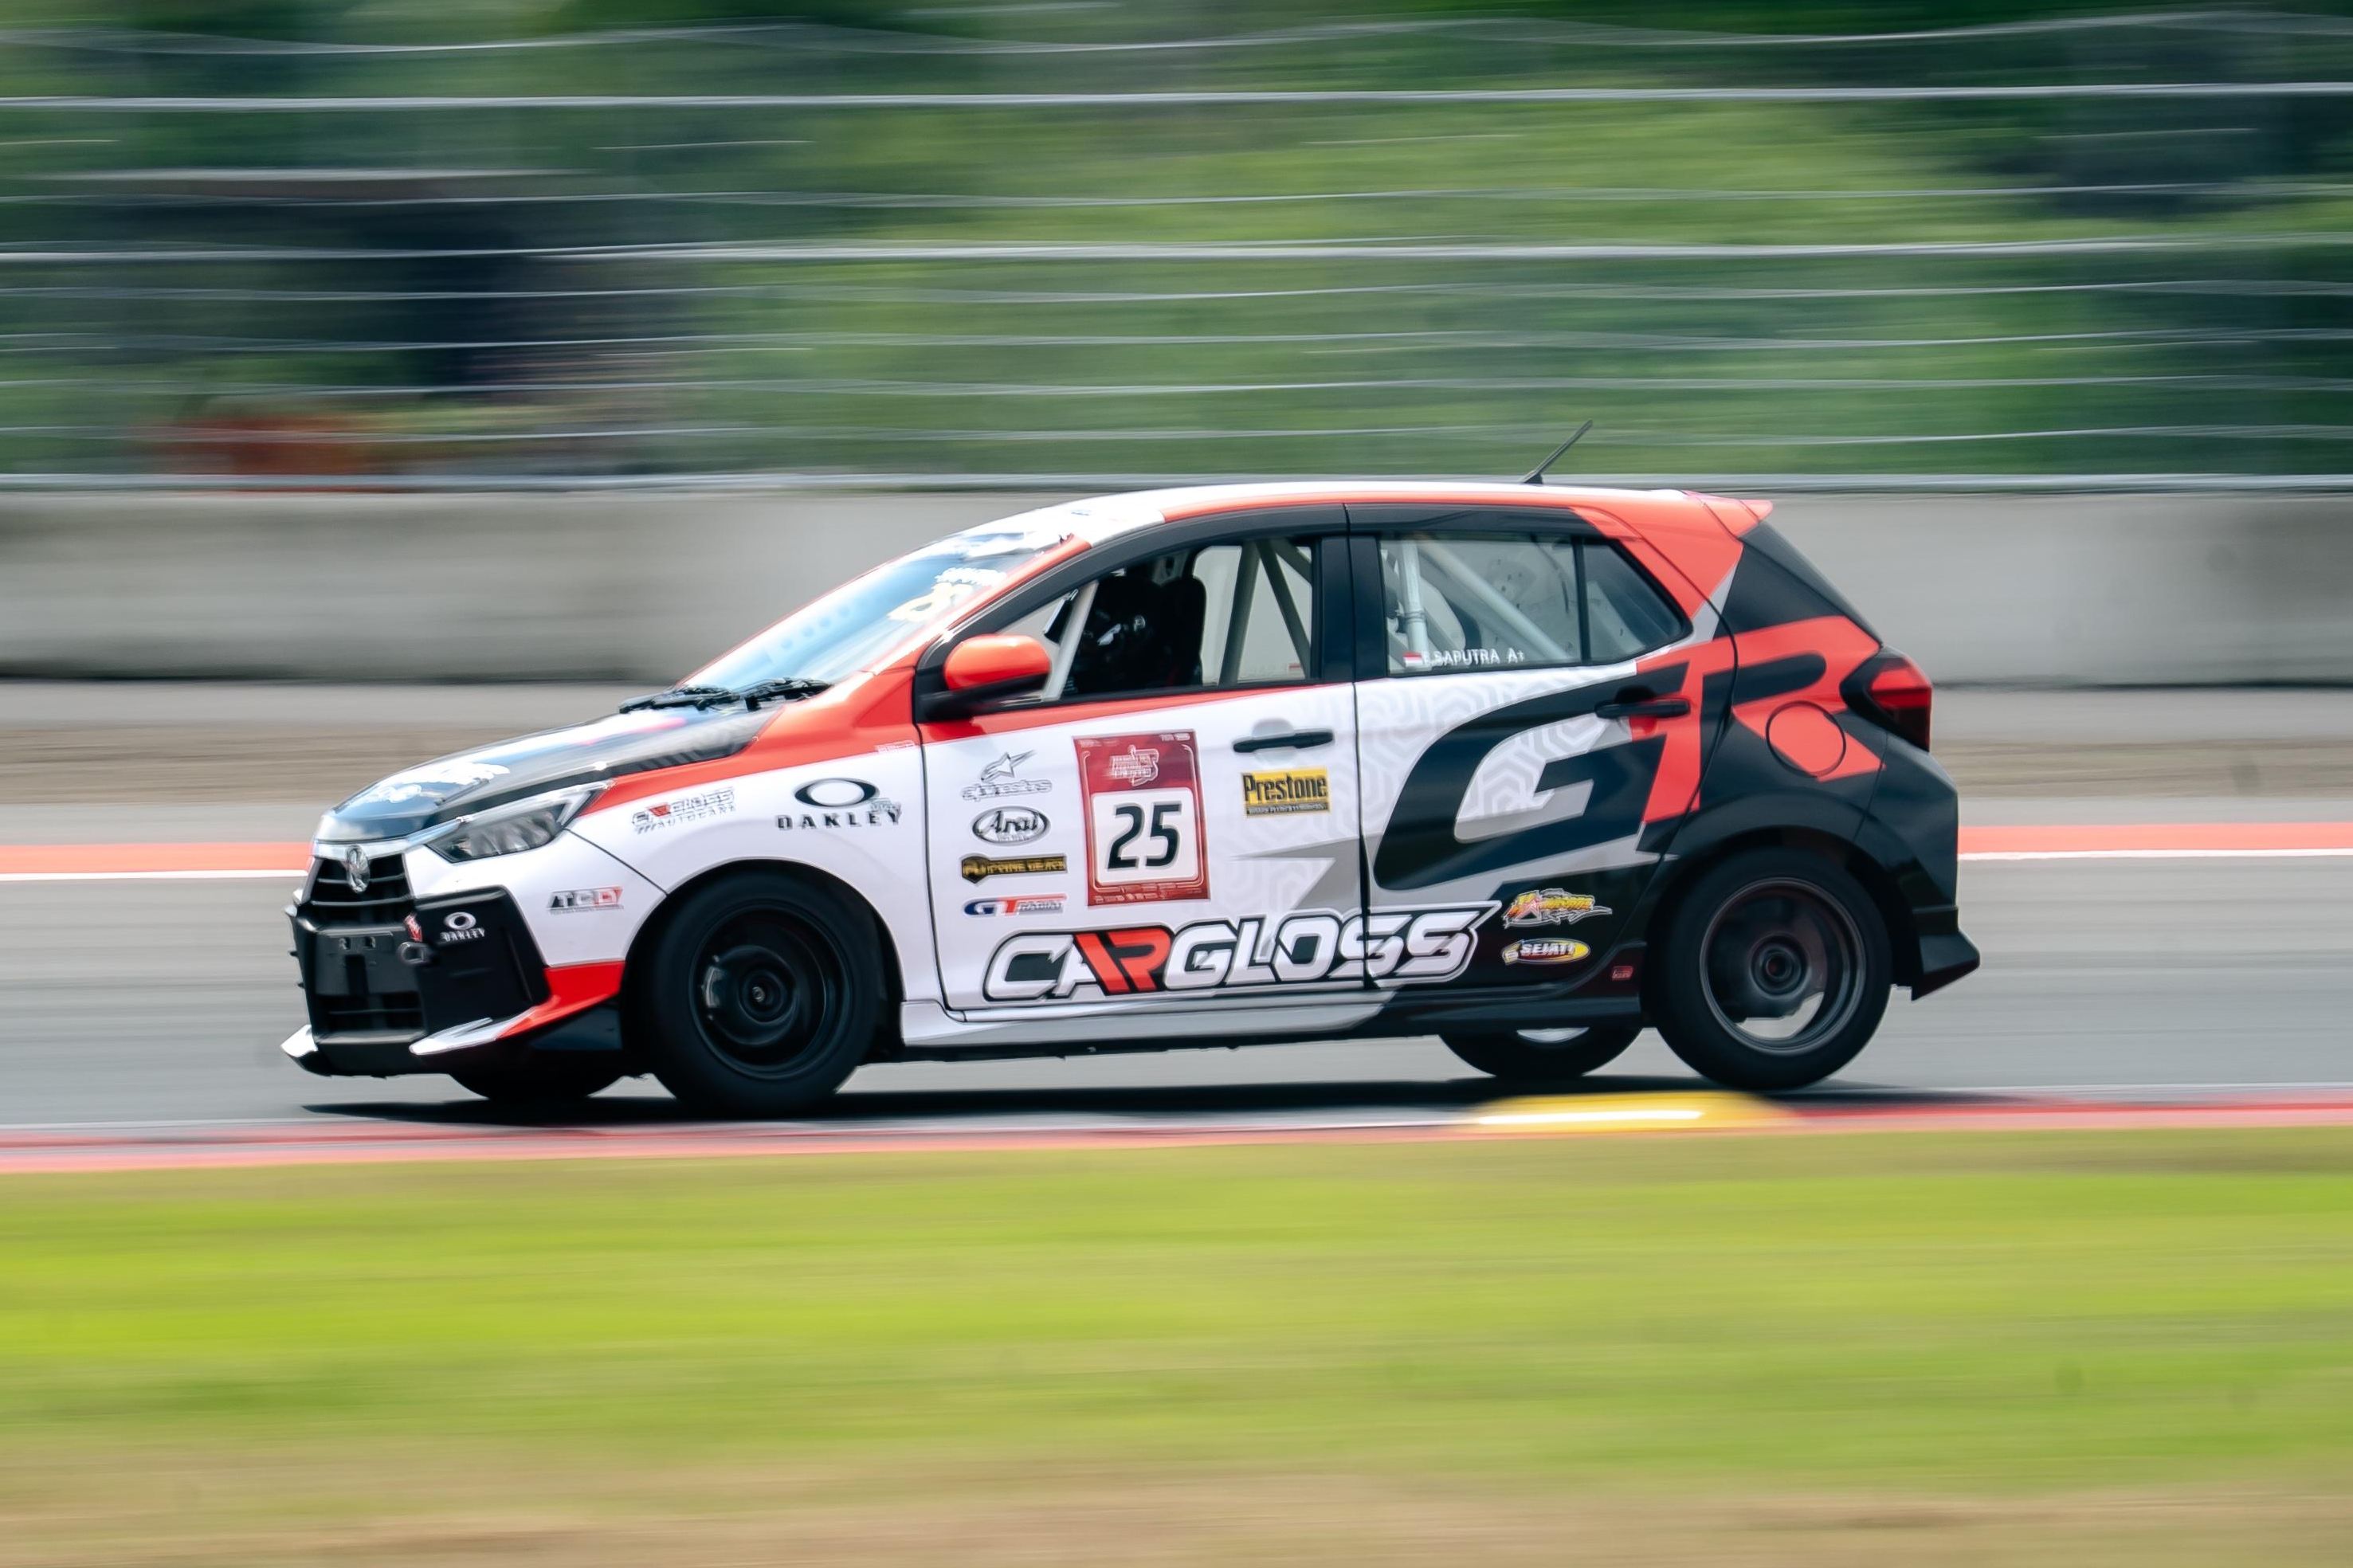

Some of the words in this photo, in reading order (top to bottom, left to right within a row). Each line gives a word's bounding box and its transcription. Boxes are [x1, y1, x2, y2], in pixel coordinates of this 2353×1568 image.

[1242, 773, 1328, 802] Prestone
[775, 802, 902, 831] OAKLEY
[979, 809, 1038, 834] Arai
[1107, 802, 1182, 871] 25
[963, 896, 1019, 915] GT
[984, 903, 1485, 1002] CARGLOSS
